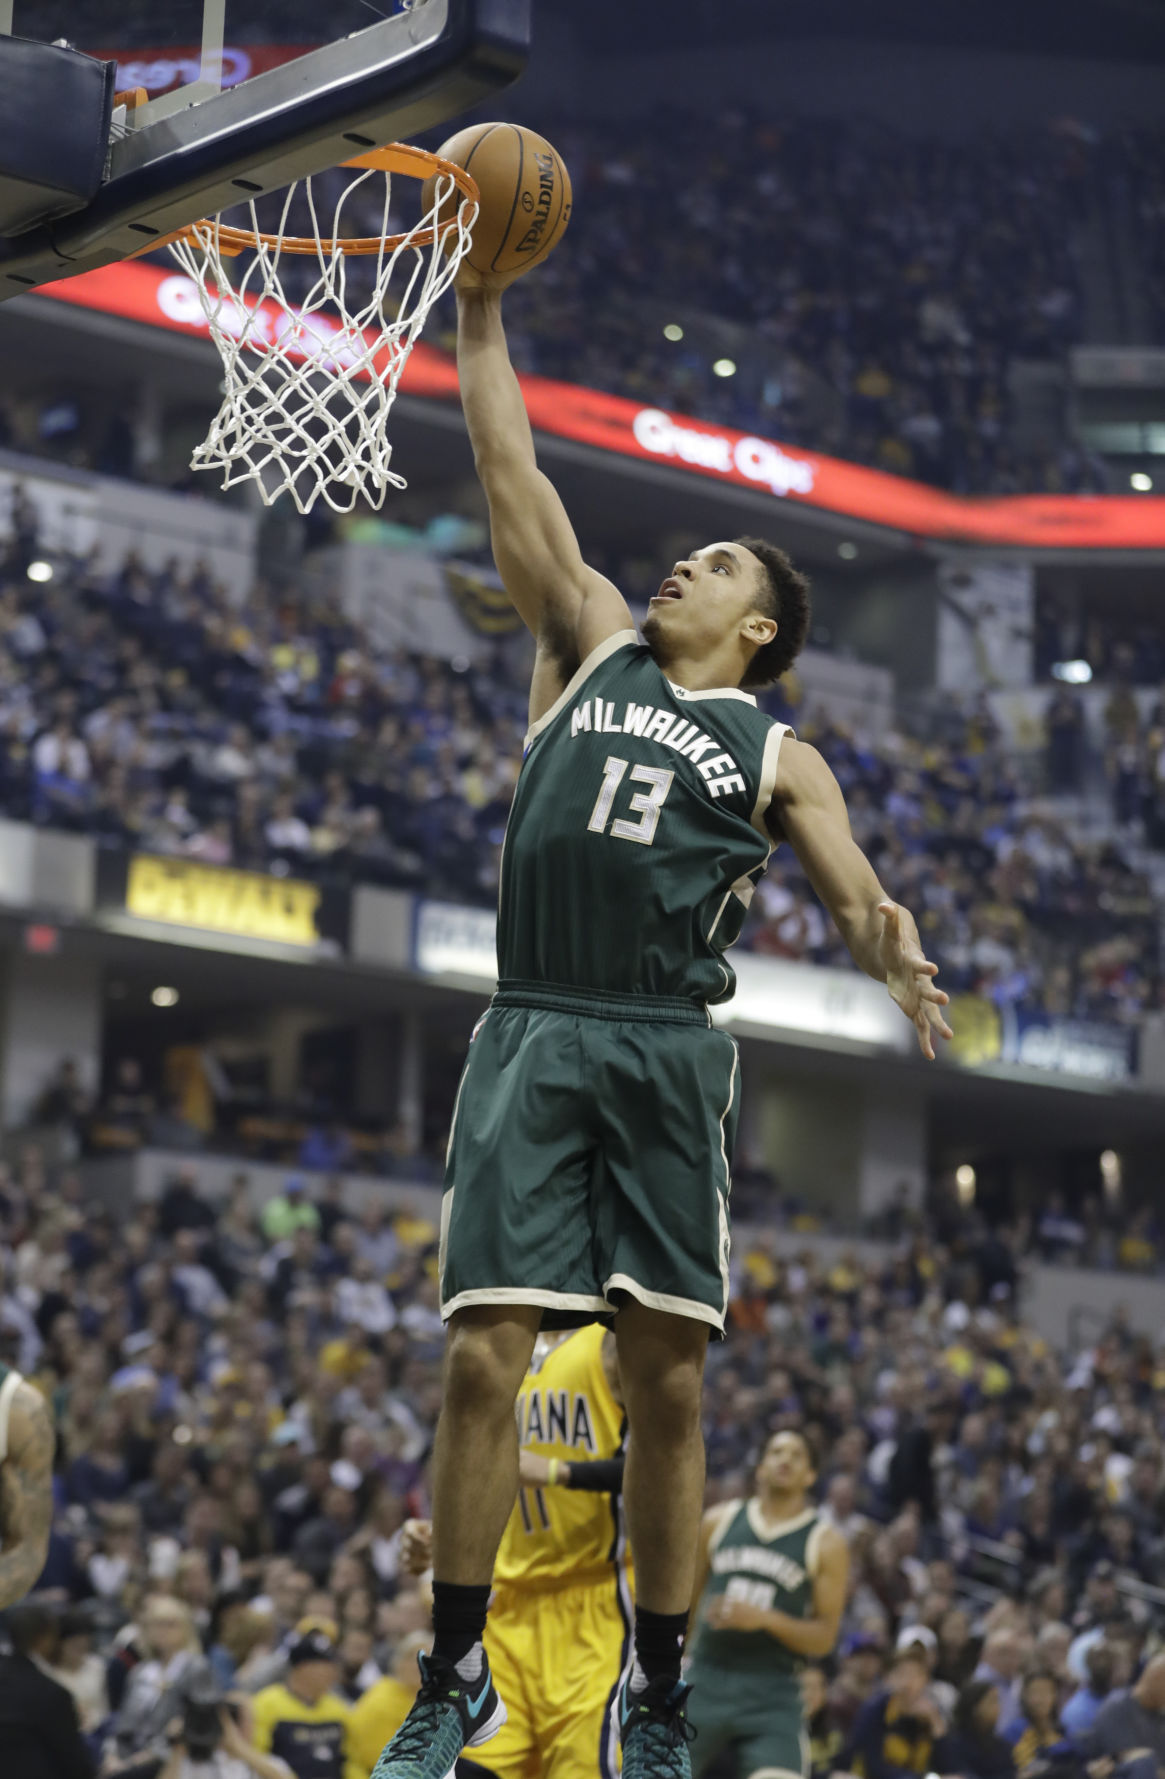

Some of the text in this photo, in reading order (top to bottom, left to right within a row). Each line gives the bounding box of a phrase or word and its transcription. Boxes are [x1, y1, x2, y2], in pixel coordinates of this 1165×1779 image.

[514, 152, 555, 252] SPALDING
[571, 697, 747, 798] MILWAUKEE
[587, 756, 675, 845] 13
